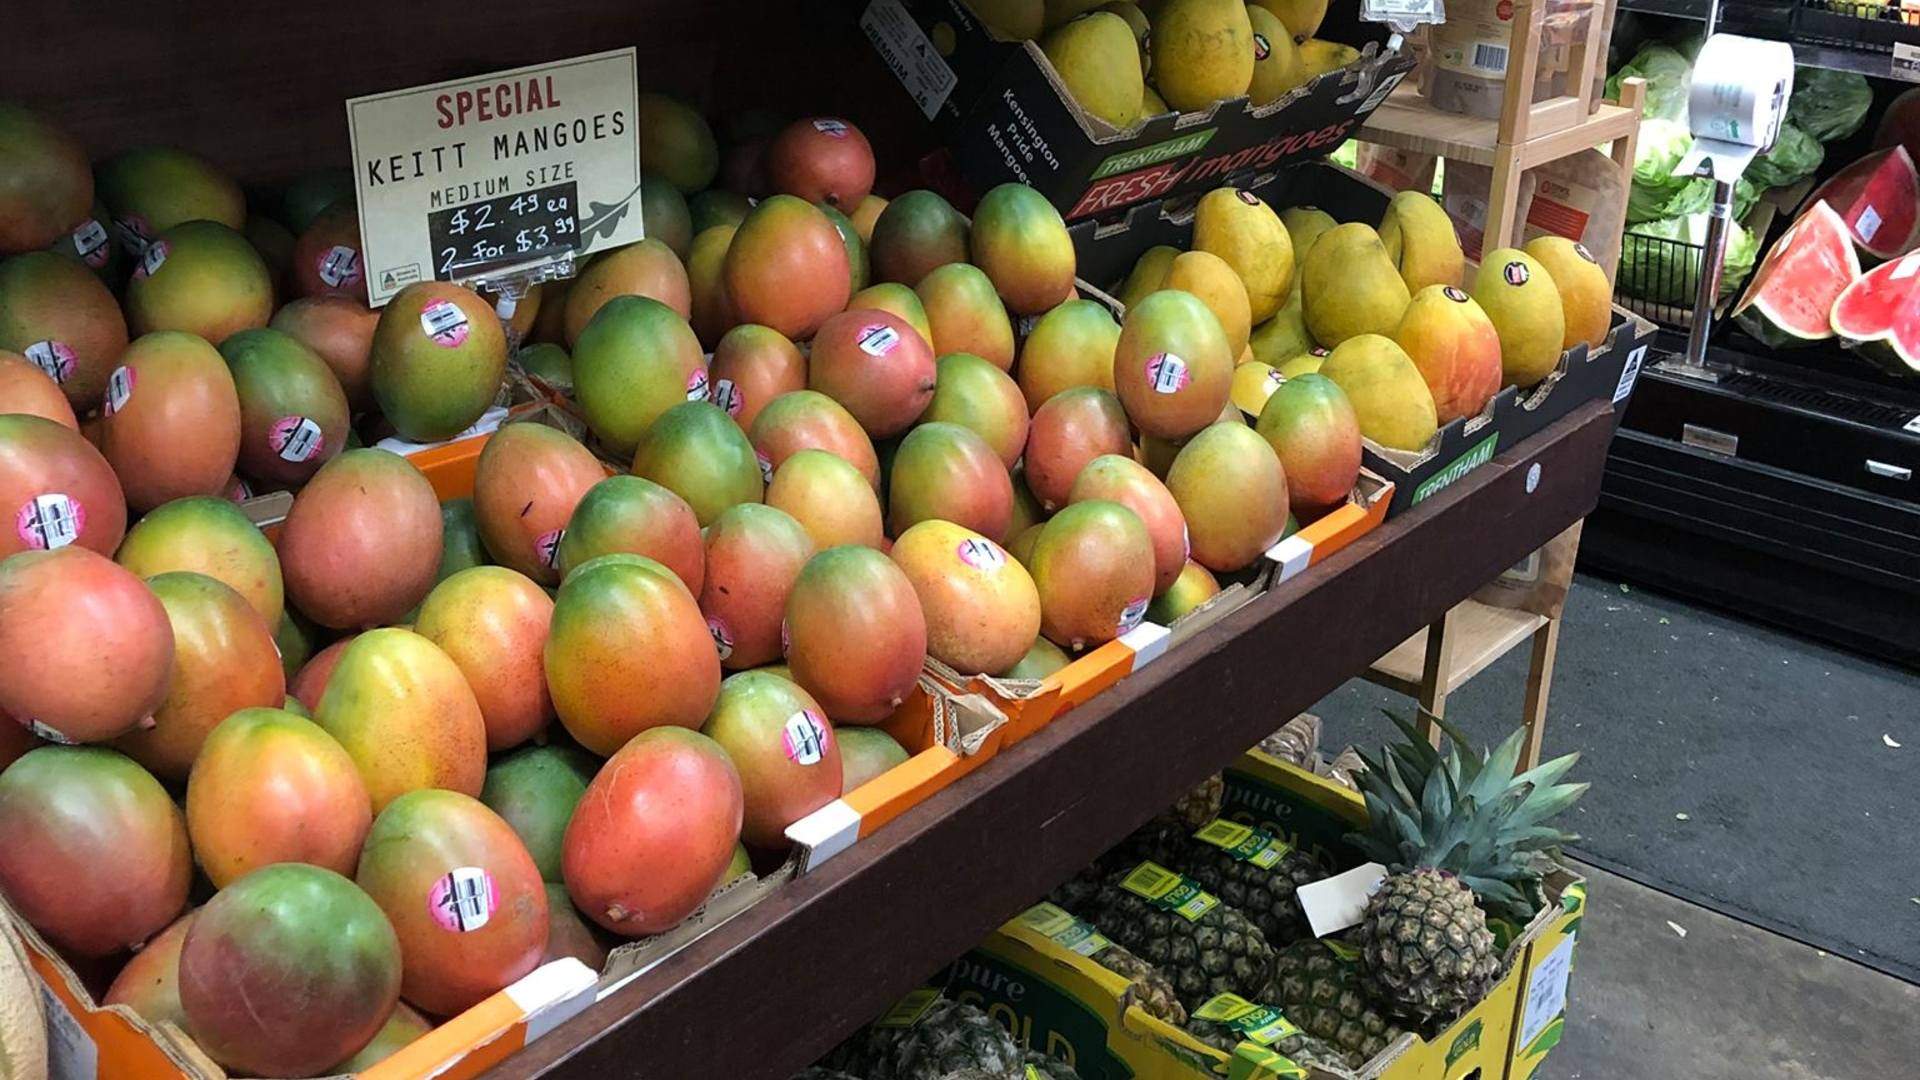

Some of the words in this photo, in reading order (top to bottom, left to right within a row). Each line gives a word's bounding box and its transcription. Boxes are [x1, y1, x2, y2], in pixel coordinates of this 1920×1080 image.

[436, 76, 560, 129] SPECIAL
[1003, 88, 1060, 170] Kensington
[368, 143, 466, 187] KEITT
[494, 111, 625, 160] MANGOES
[1006, 123, 1034, 163] Pride
[1072, 168, 1183, 217] FRESH
[1186, 119, 1355, 183] mangoes
[1103, 136, 1206, 175] TRENTHAM
[430, 176, 510, 208] MEDIUM
[526, 162, 575, 187] SIZE
[1419, 442, 1491, 502] TRENTHAM
[951, 957, 1027, 1001] pure
[957, 989, 1077, 1069] OLD
